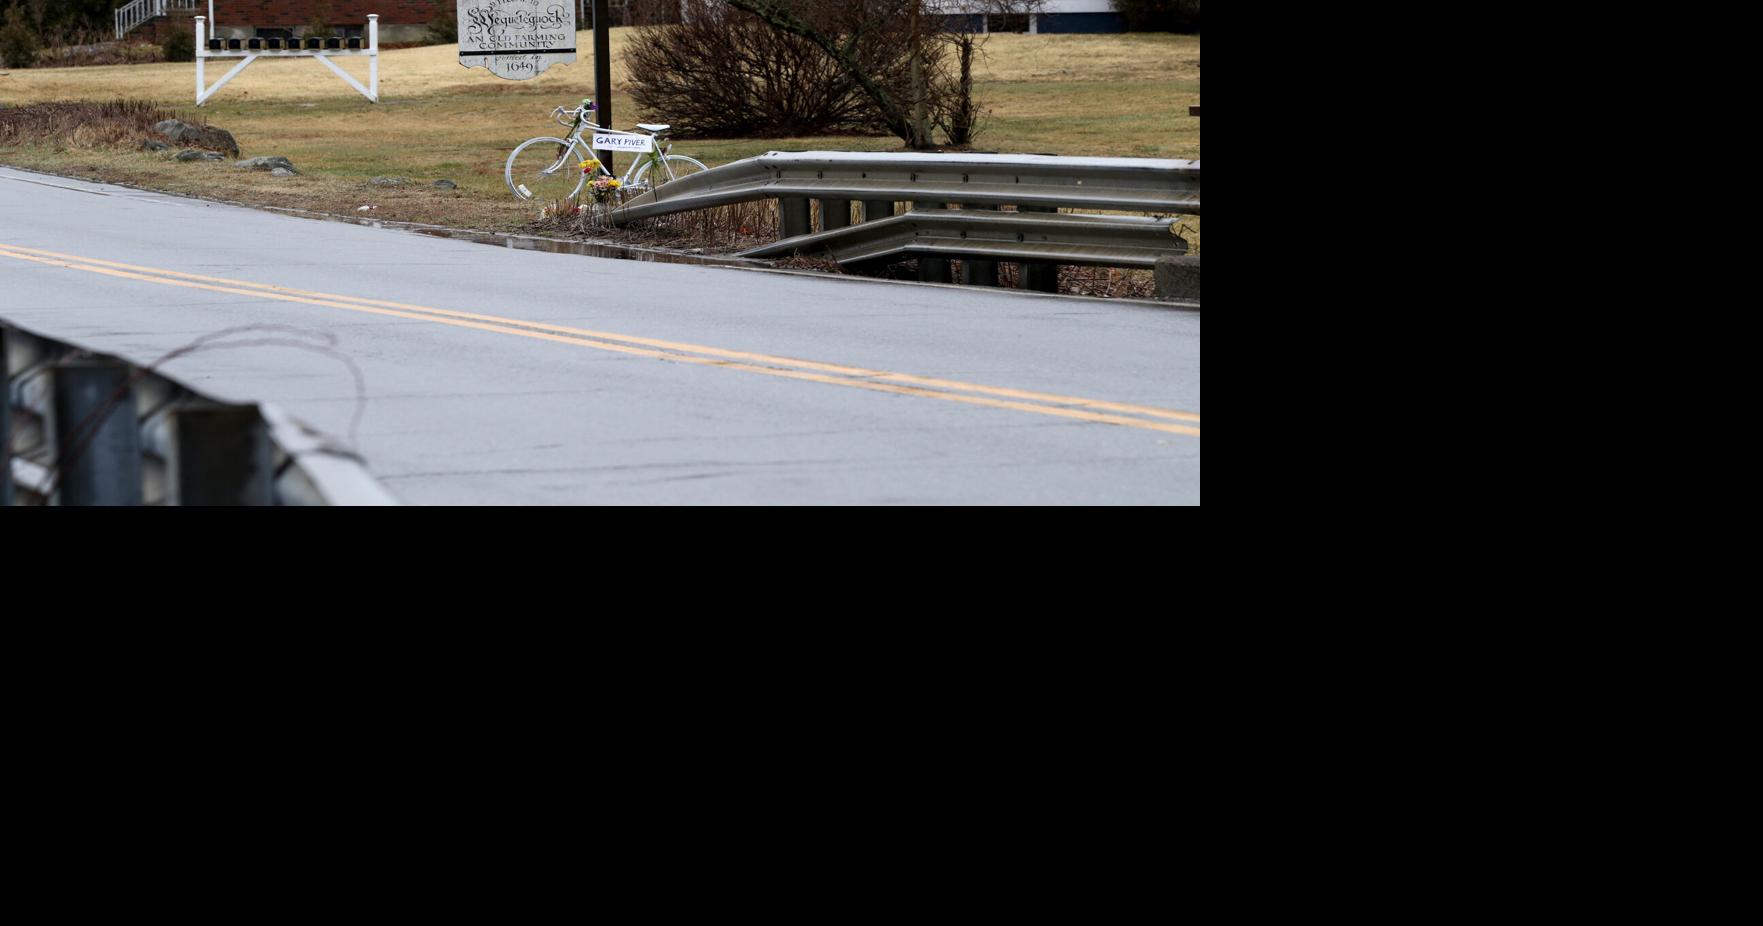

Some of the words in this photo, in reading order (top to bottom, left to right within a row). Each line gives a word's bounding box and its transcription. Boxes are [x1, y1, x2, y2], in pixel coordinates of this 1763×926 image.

[468, 35, 484, 43] AN
[489, 35, 511, 43] OLD
[515, 33, 566, 42] FARMING
[479, 41, 555, 49] COMMUNITY
[507, 61, 533, 72] 1649
[596, 136, 622, 145] GARY
